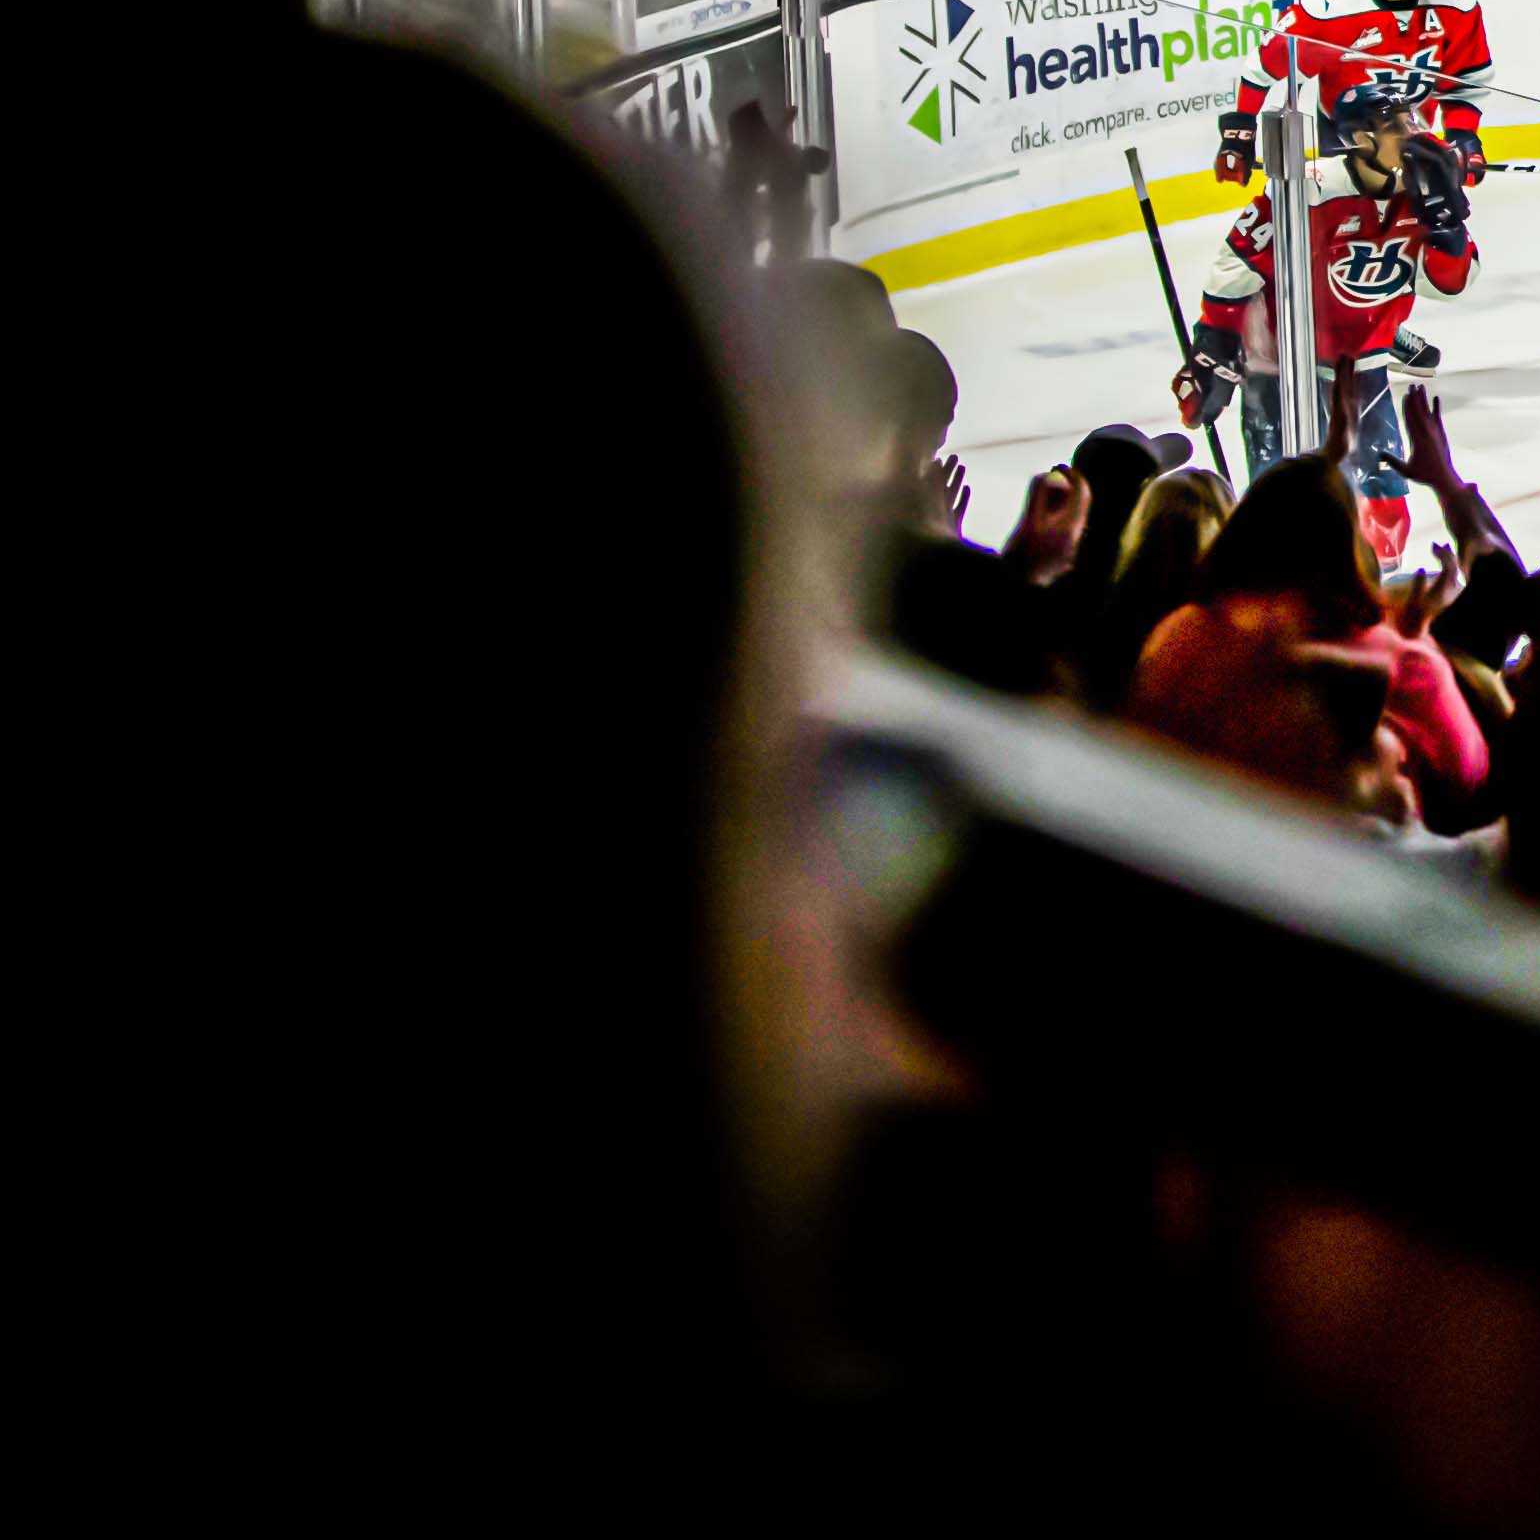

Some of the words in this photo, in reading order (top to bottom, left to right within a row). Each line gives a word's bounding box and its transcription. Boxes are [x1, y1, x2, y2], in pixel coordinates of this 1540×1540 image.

[691, 0, 734, 29] gerber
[1424, 9, 1441, 31] A
[1012, 121, 1055, 153] click.
[1064, 107, 1150, 140] compare.
[1233, 203, 1273, 253] 24
